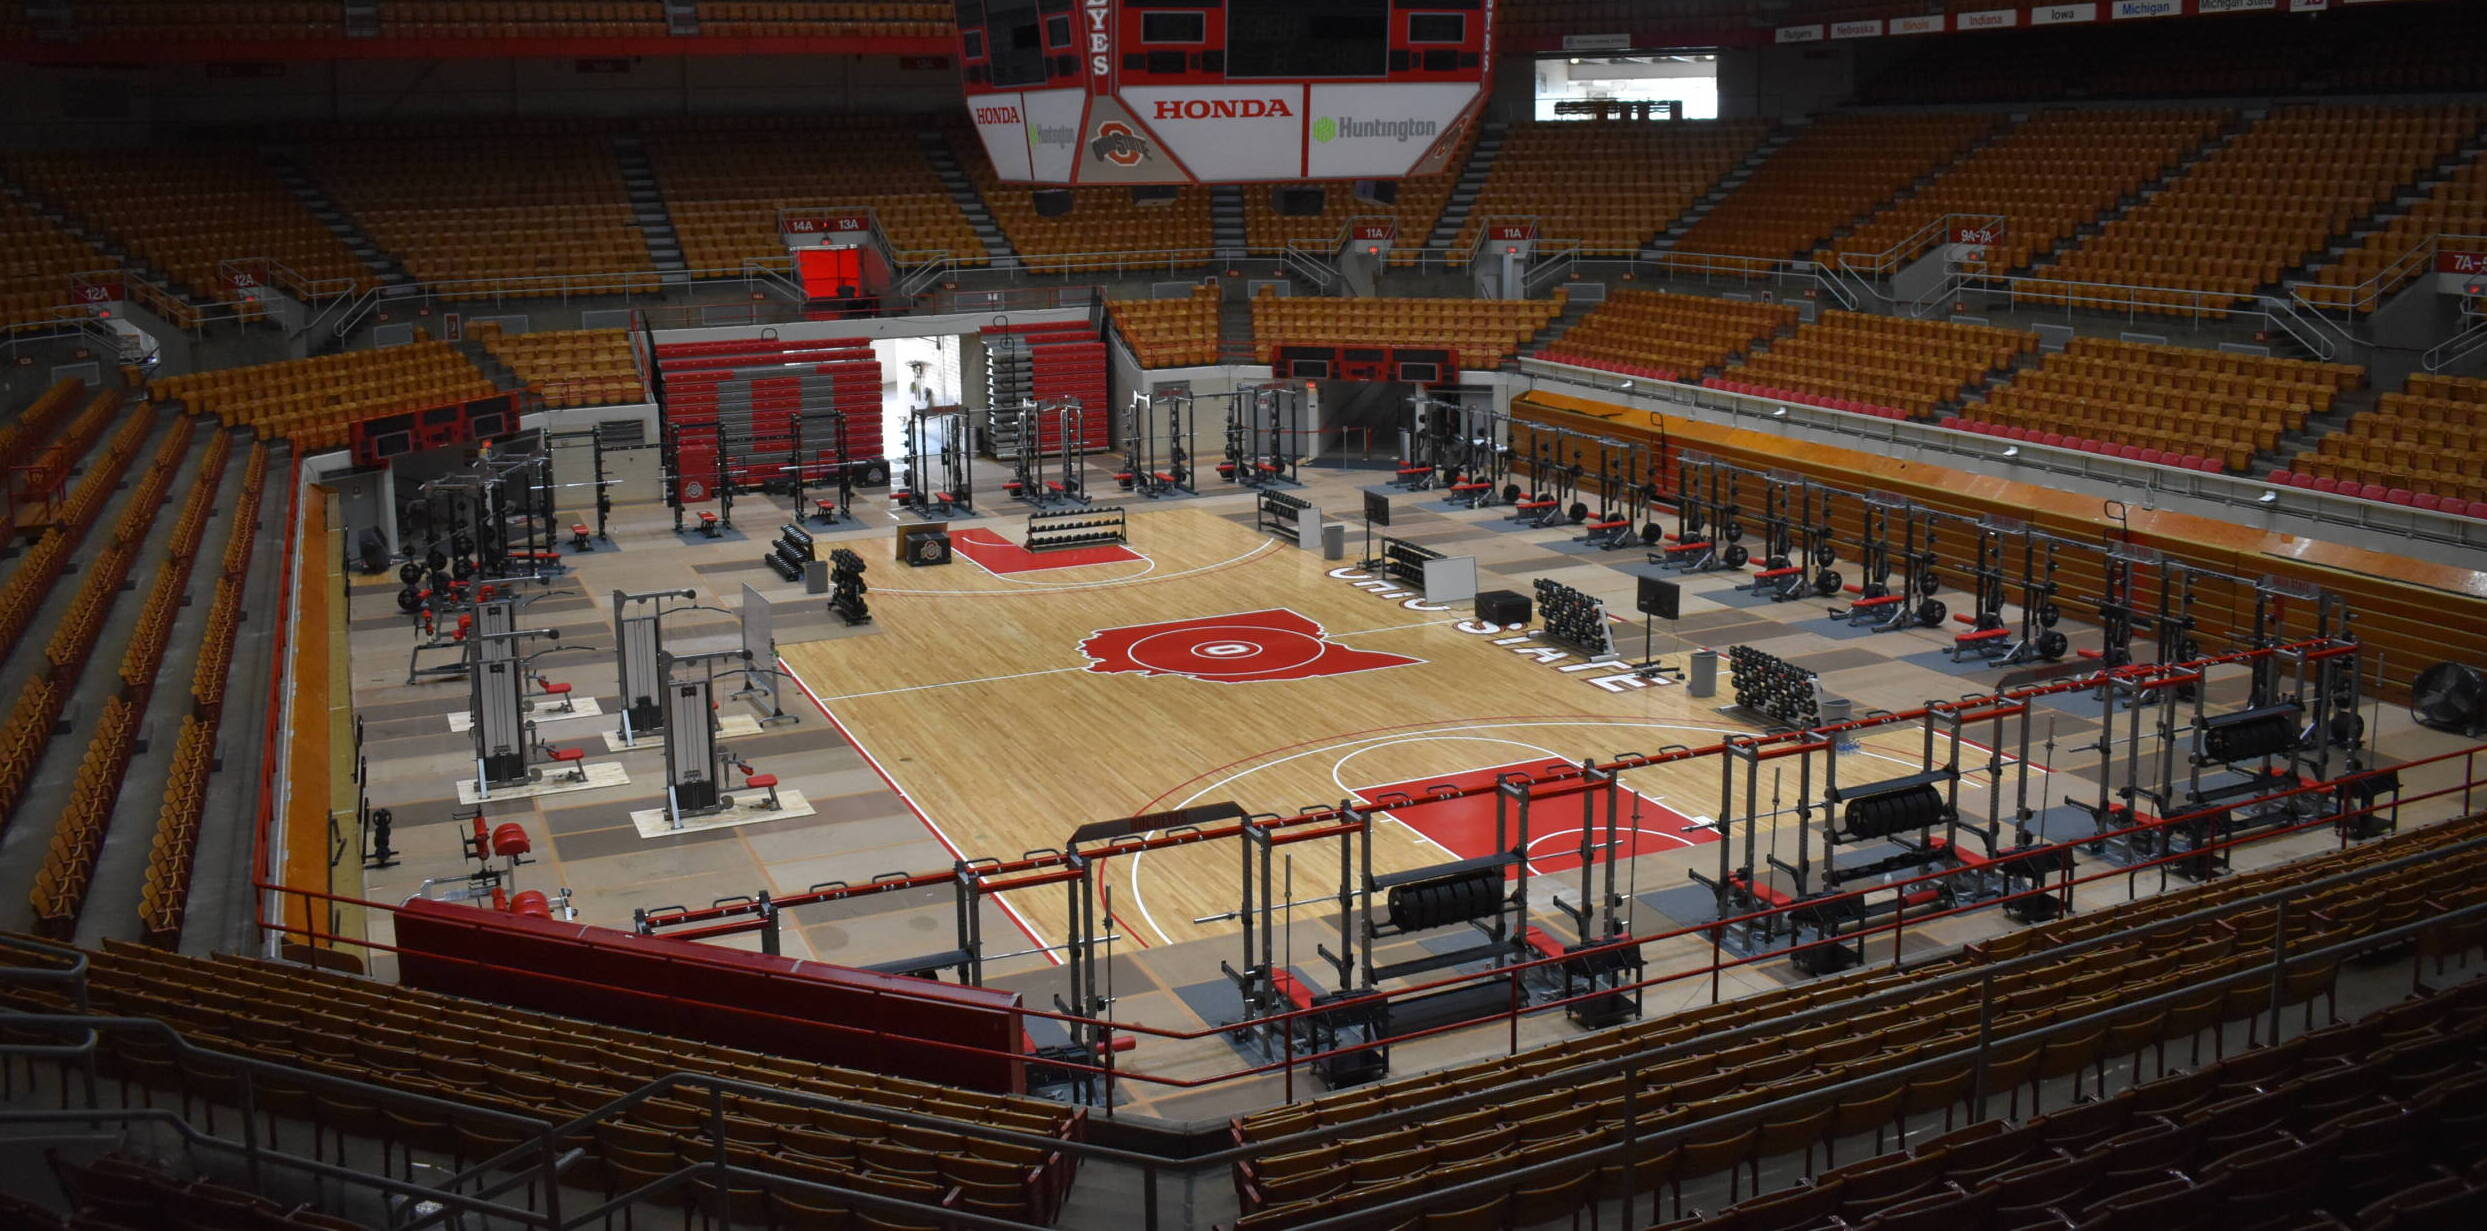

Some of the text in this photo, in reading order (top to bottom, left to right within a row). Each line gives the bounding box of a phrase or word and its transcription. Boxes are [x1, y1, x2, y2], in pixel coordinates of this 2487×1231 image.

[2051, 8, 2075, 20] Iowa
[2121, 3, 2170, 16] Michigan
[976, 106, 1021, 124] HONDA
[1153, 98, 1293, 120] HONDA
[1338, 116, 1437, 142] Huntington
[792, 220, 814, 232] 14A
[838, 218, 859, 231] 13A
[1365, 227, 1383, 238] 11A
[1503, 228, 1522, 239] 11A
[85, 287, 108, 300] 12A
